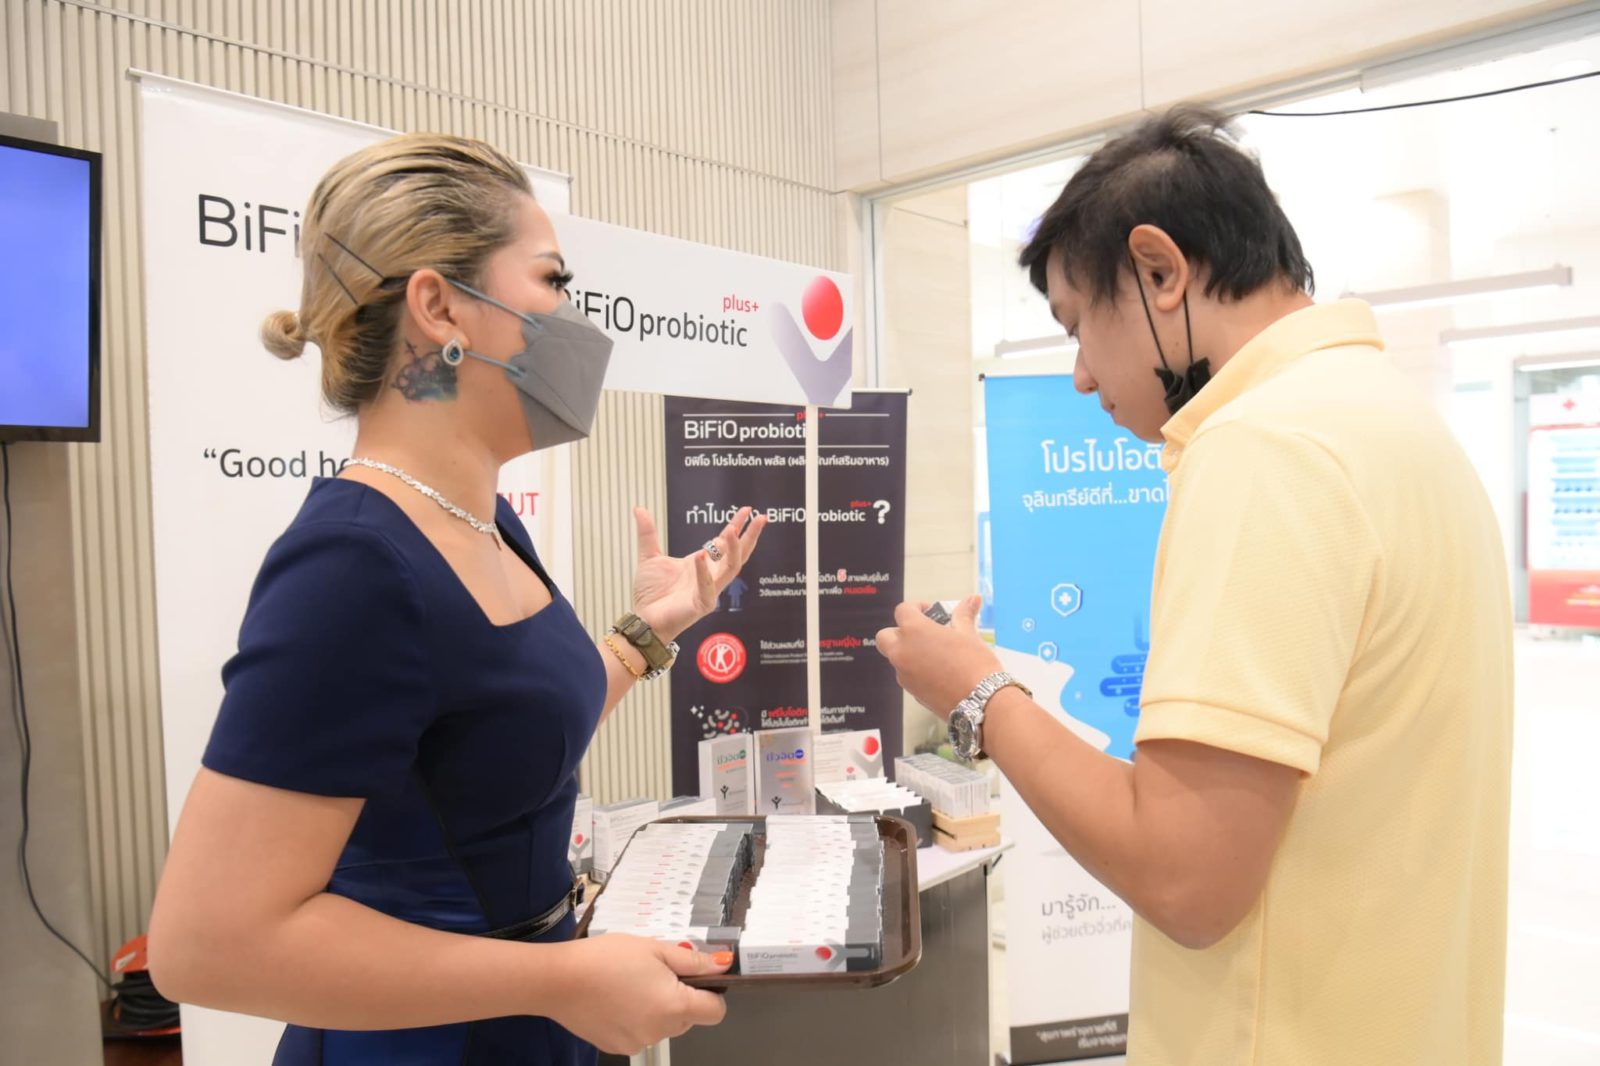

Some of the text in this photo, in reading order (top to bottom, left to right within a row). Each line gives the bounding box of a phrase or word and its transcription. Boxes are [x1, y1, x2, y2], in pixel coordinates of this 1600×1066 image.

[198, 194, 300, 258] BiFi
[564, 288, 635, 333] iFiO
[723, 294, 759, 313] plus+
[740, 422, 806, 442] probioti
[1040, 437, 1162, 474] โปรไบโอติ
[497, 492, 540, 516] UT
[686, 502, 760, 524] ทำไมต้ง
[818, 508, 866, 522] robiotic
[872, 499, 891, 525] ?
